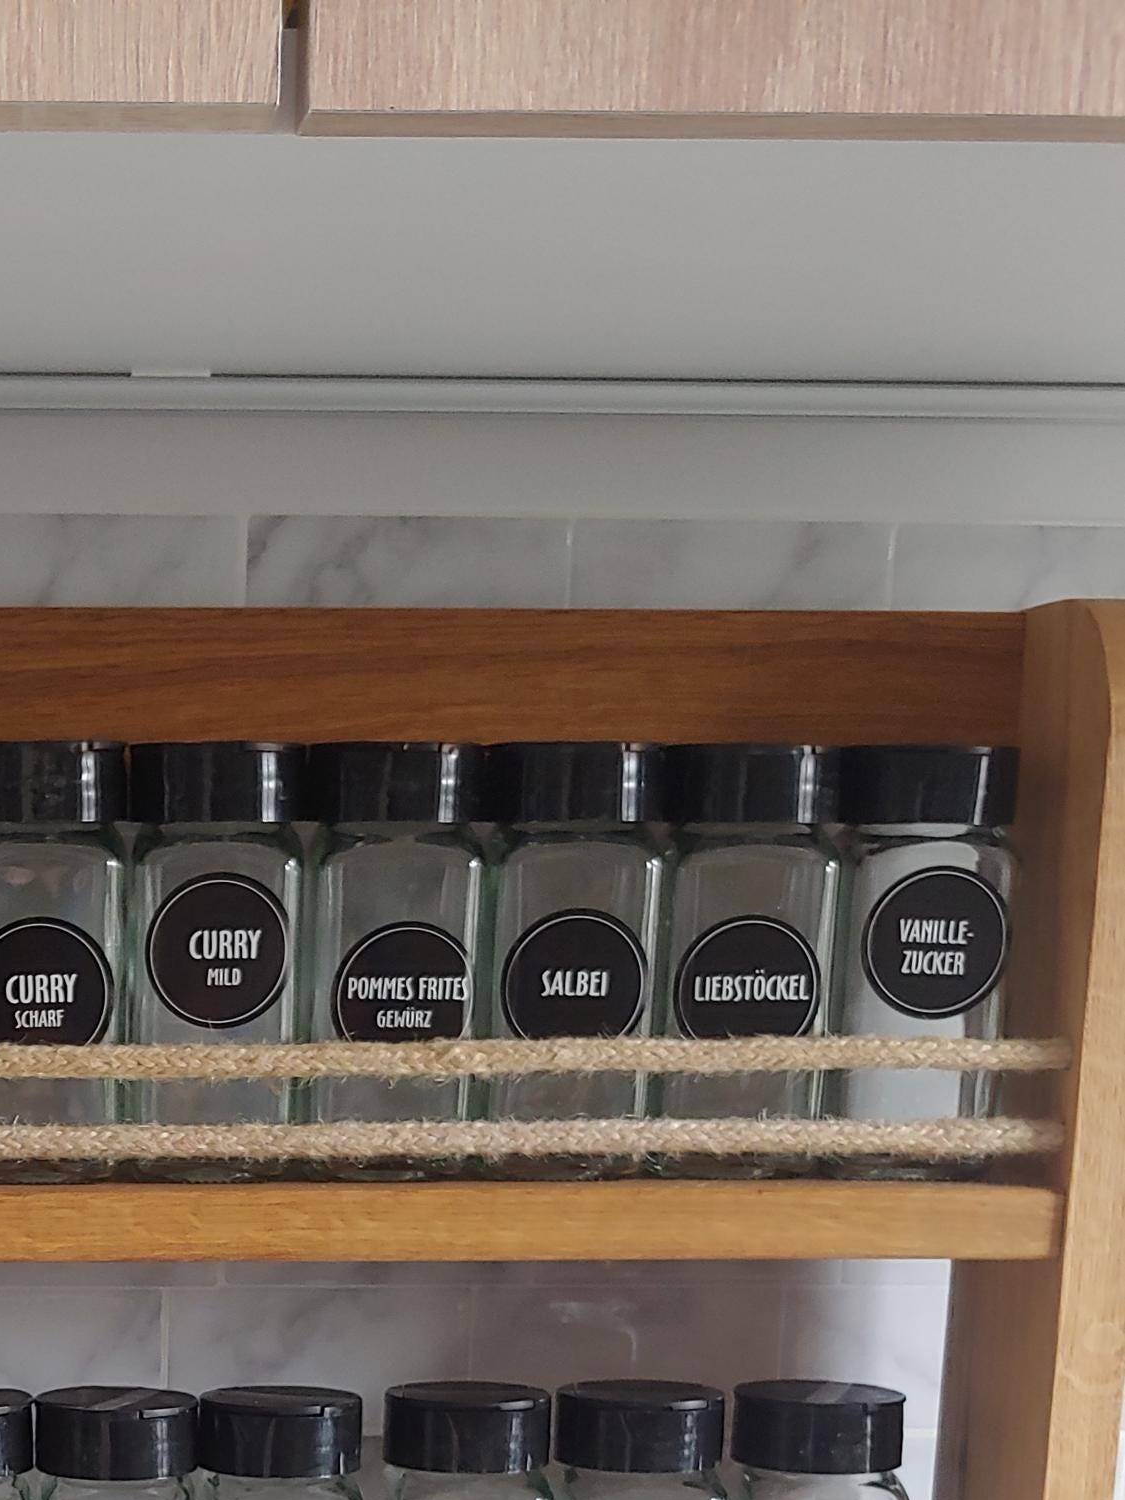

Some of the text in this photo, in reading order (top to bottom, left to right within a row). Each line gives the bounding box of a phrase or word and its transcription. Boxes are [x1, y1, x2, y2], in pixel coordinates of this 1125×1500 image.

[189, 929, 262, 960] CURRY
[899, 919, 975, 945] VANILLE-
[901, 950, 965, 976] ZUCKER
[6, 974, 78, 1005] CURRY
[206, 968, 241, 987] MILD
[348, 976, 468, 1001] POMMES FRITES
[541, 970, 610, 997] SALBEI
[694, 969, 809, 1001] LIEBSTÖCKEL
[14, 1009, 64, 1029] SCHARF
[376, 1007, 433, 1029] GEWÜRZ
